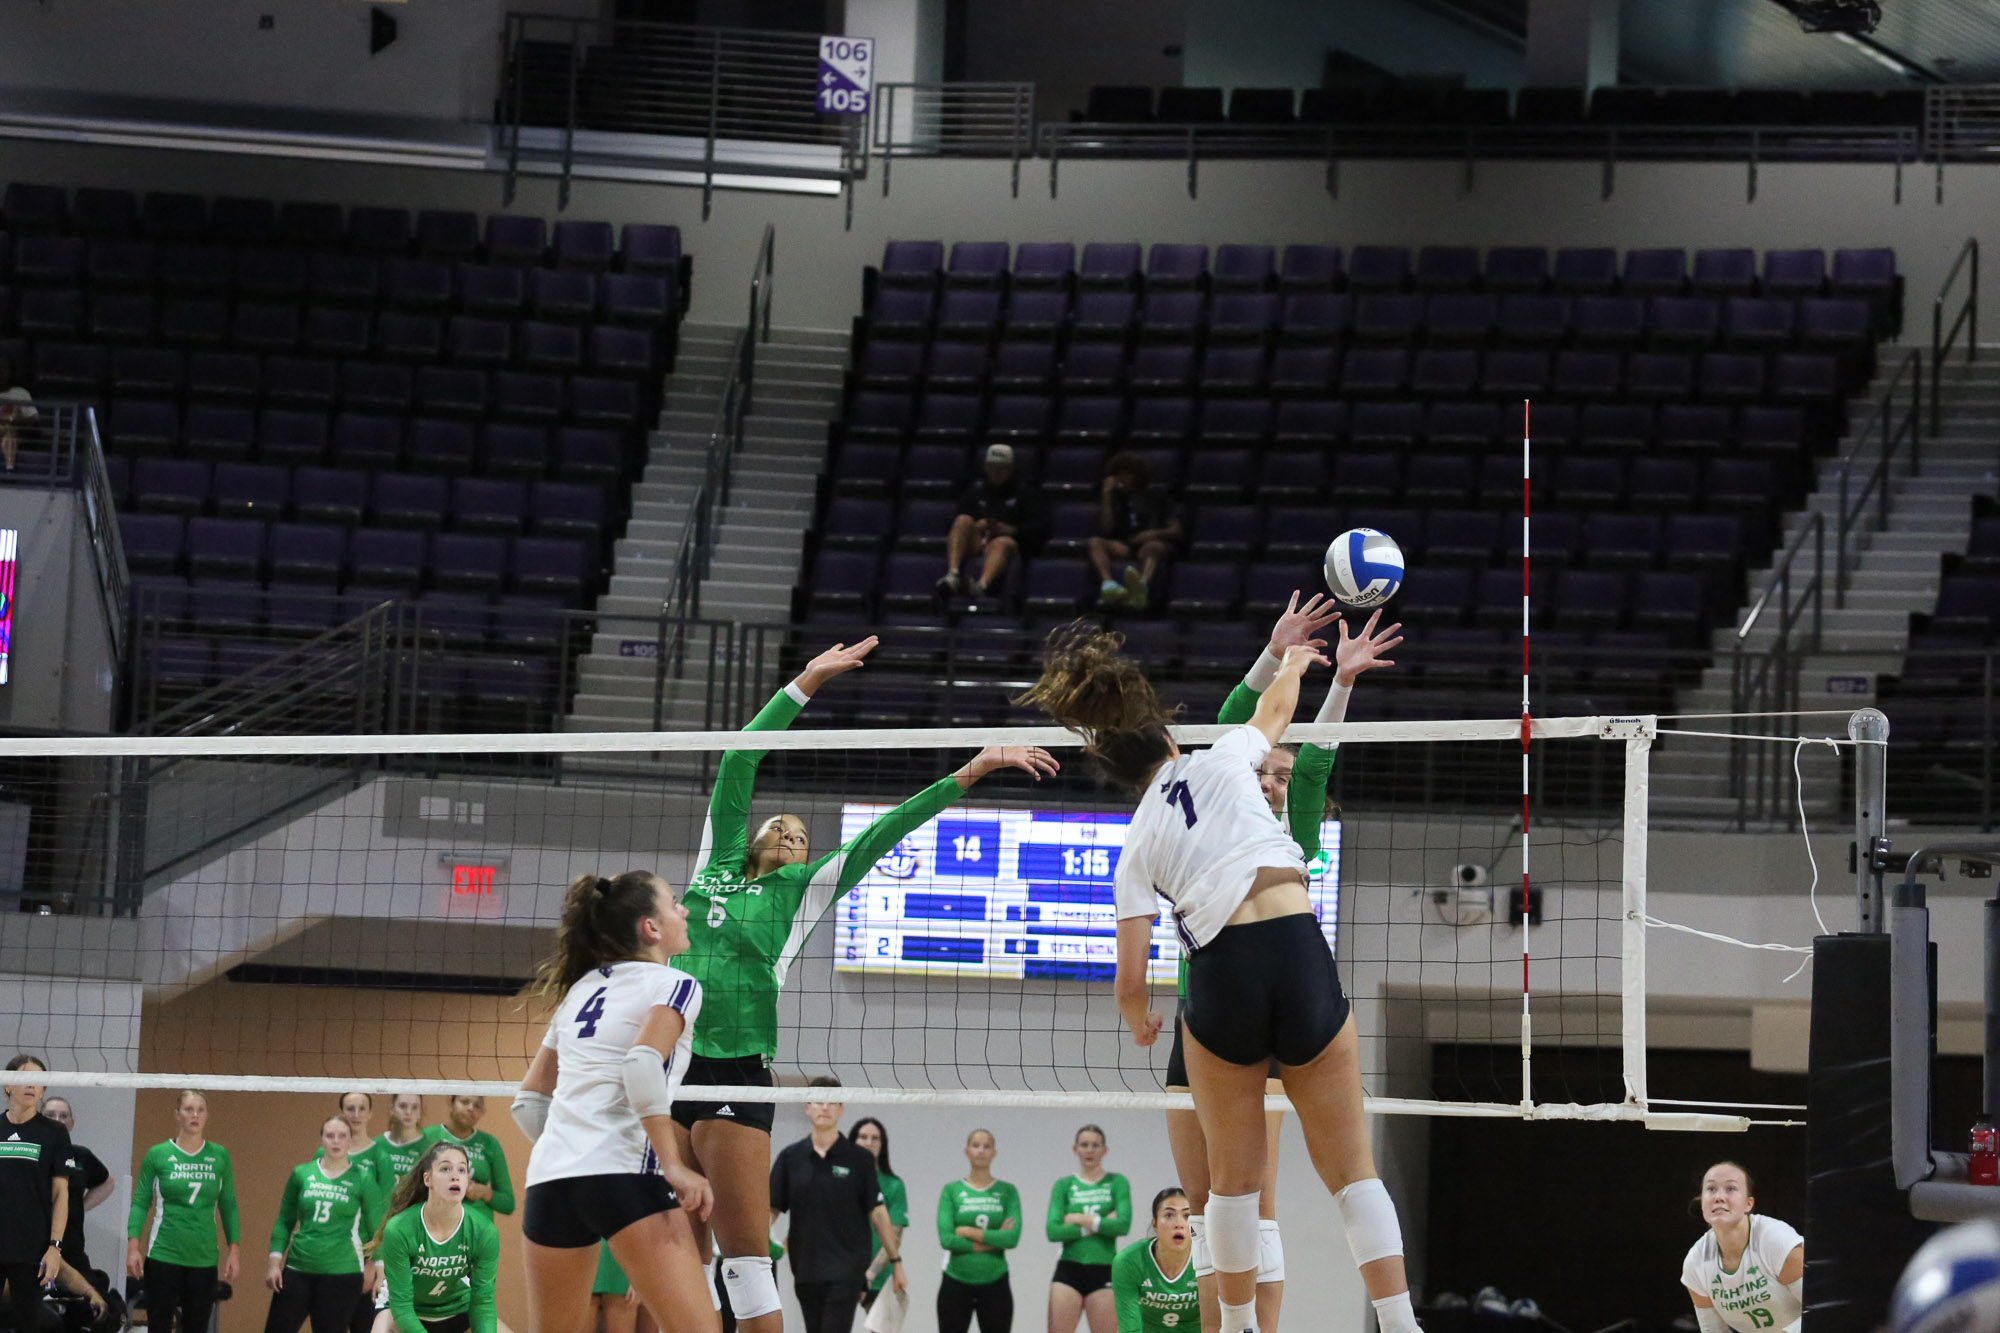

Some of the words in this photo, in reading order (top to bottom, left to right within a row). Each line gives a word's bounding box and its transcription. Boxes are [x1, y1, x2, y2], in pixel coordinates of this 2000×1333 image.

[825, 40, 867, 62] 106
[820, 88, 867, 112] 105
[952, 835, 982, 862] 14
[1062, 848, 1110, 877] 1:15
[454, 866, 496, 895] EXIT
[877, 937, 890, 956] 2
[574, 986, 608, 1039] 4
[169, 1171, 216, 1180] DAKOTA
[173, 1162, 214, 1172] NORTH
[188, 1181, 202, 1205] 7
[313, 1200, 334, 1223] 13
[417, 1254, 467, 1268] NORTH
[428, 1280, 448, 1297] 4
[1145, 1290, 1198, 1302] NORTH
[1720, 1290, 1772, 1311] HAWKS
[1743, 1307, 1775, 1329] 19
